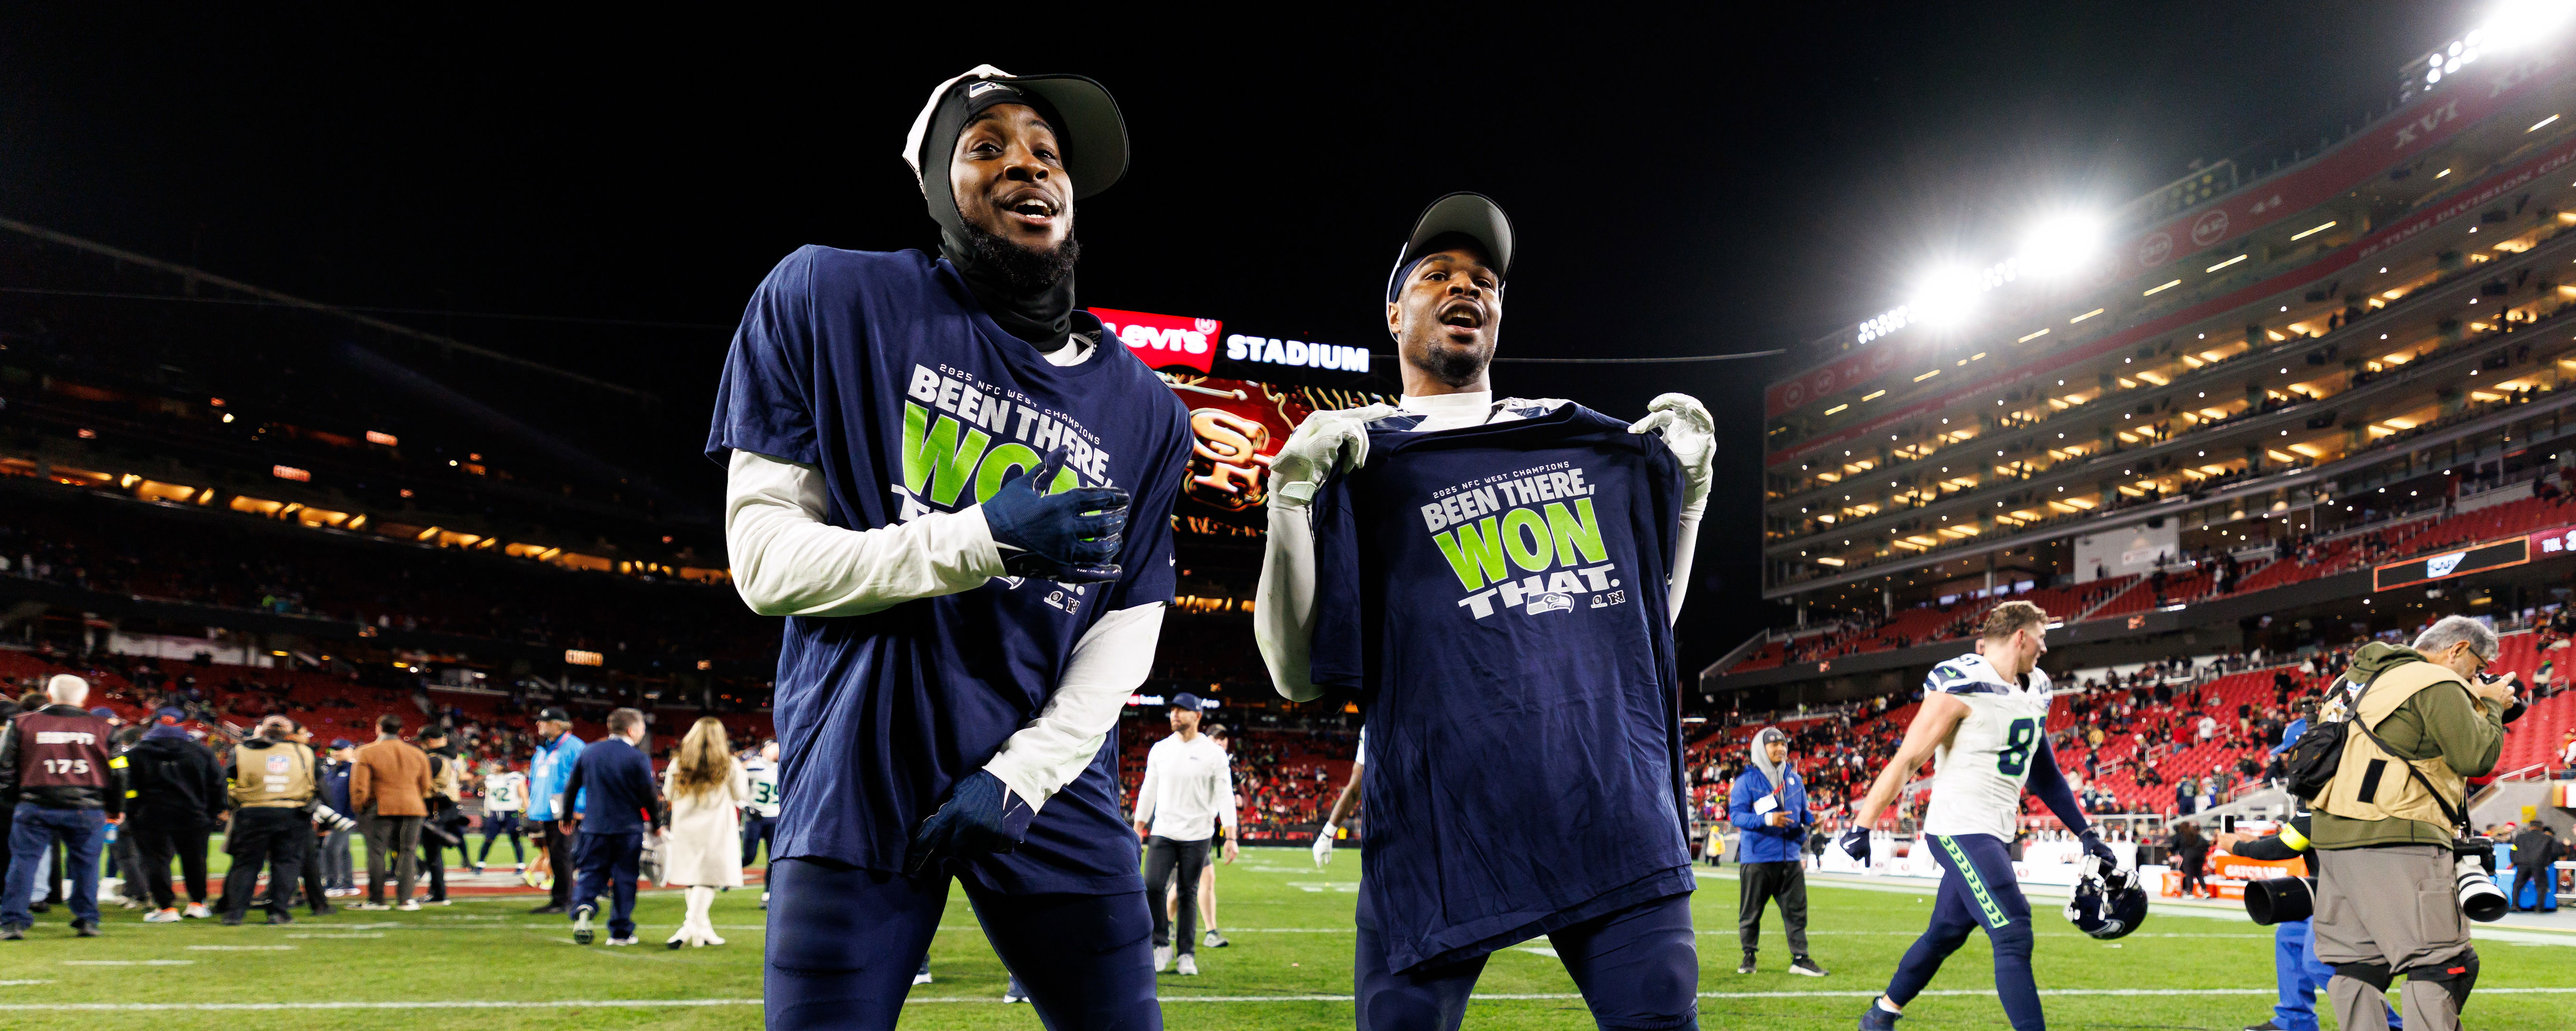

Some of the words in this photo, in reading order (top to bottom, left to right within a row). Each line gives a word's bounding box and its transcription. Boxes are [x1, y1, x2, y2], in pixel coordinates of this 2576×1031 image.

[1227, 334, 1370, 372] STADIUM
[908, 363, 1010, 434] BEEN
[940, 363, 973, 381] 2025
[977, 380, 1001, 395] NFC
[1007, 389, 1038, 408] WEST
[1045, 409, 1100, 445] CHAMPIONS
[1421, 485, 1501, 533] BEEN
[1499, 468, 1595, 507] THERE,
[1433, 485, 1457, 499] 2025
[1462, 480, 1480, 490] NFC
[1484, 474, 1508, 483] WEST
[1513, 461, 1569, 478] CHAMPIONS
[1432, 497, 1609, 593] WON
[1458, 563, 1621, 620] THAT.
[36, 731, 95, 745] ESPN
[43, 759, 89, 774] 175
